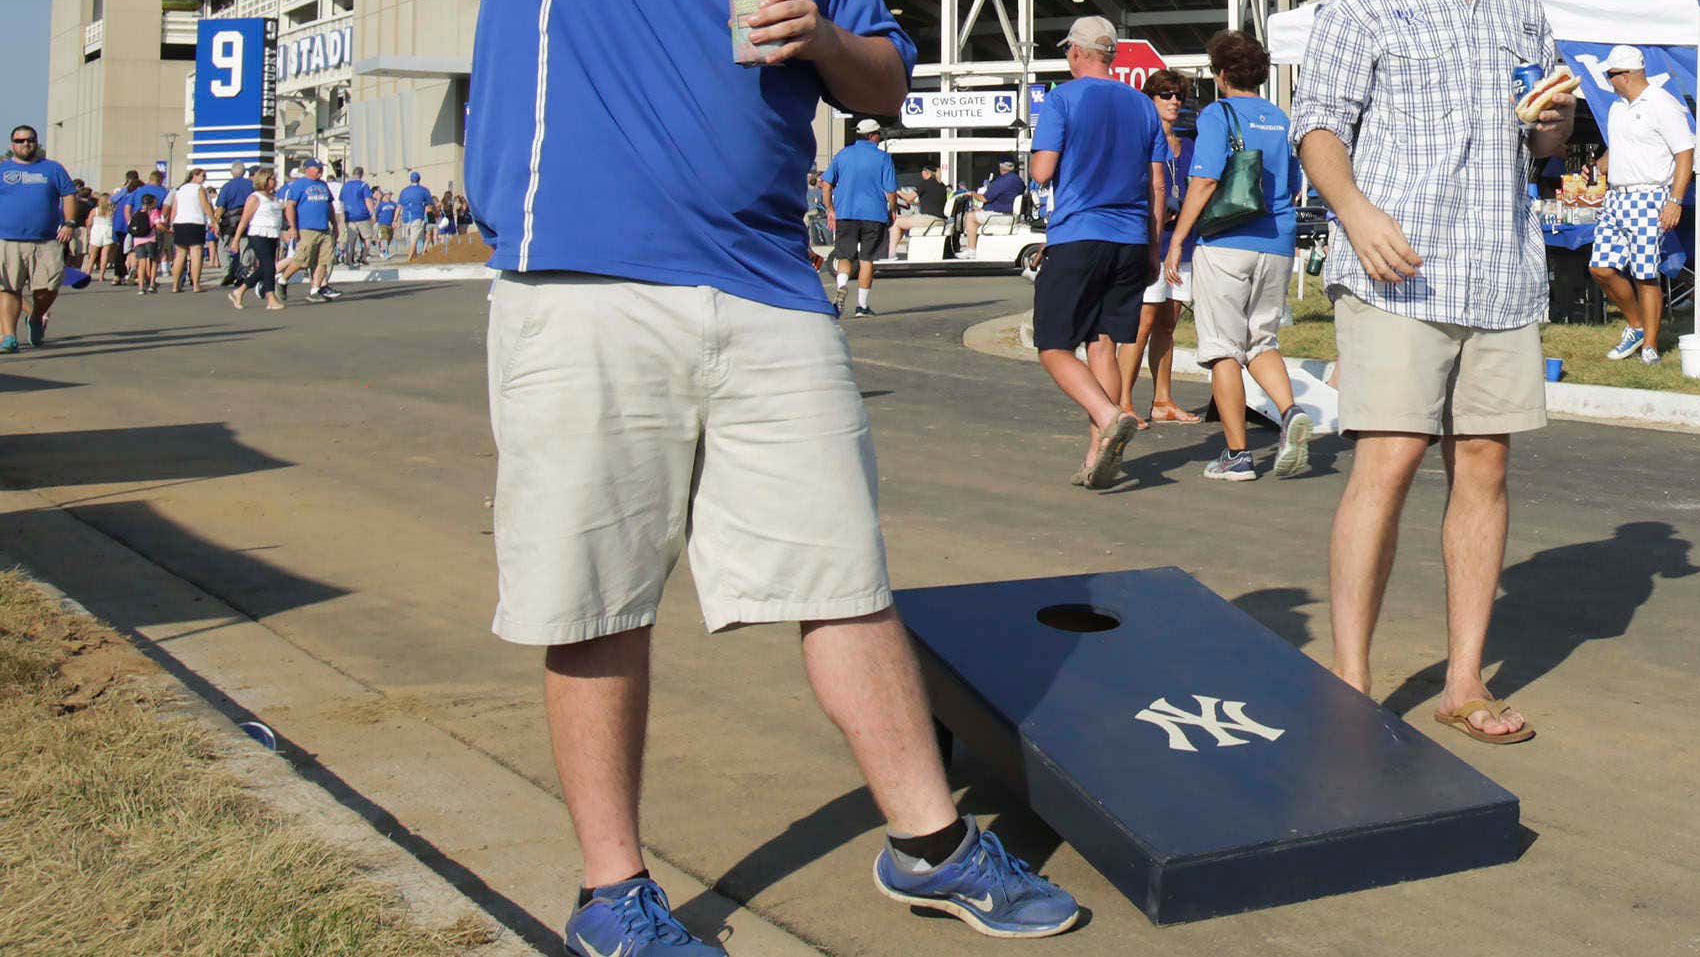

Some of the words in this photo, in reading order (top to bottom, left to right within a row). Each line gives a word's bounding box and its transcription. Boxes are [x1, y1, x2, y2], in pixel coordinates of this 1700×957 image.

[211, 30, 244, 97] 9
[287, 25, 354, 77] STADI
[262, 46, 277, 118] KENTUCKY
[931, 97, 957, 106] CWS
[959, 96, 987, 106] GATE
[936, 108, 983, 118] SHUTTLE
[1134, 694, 1286, 753] NY
